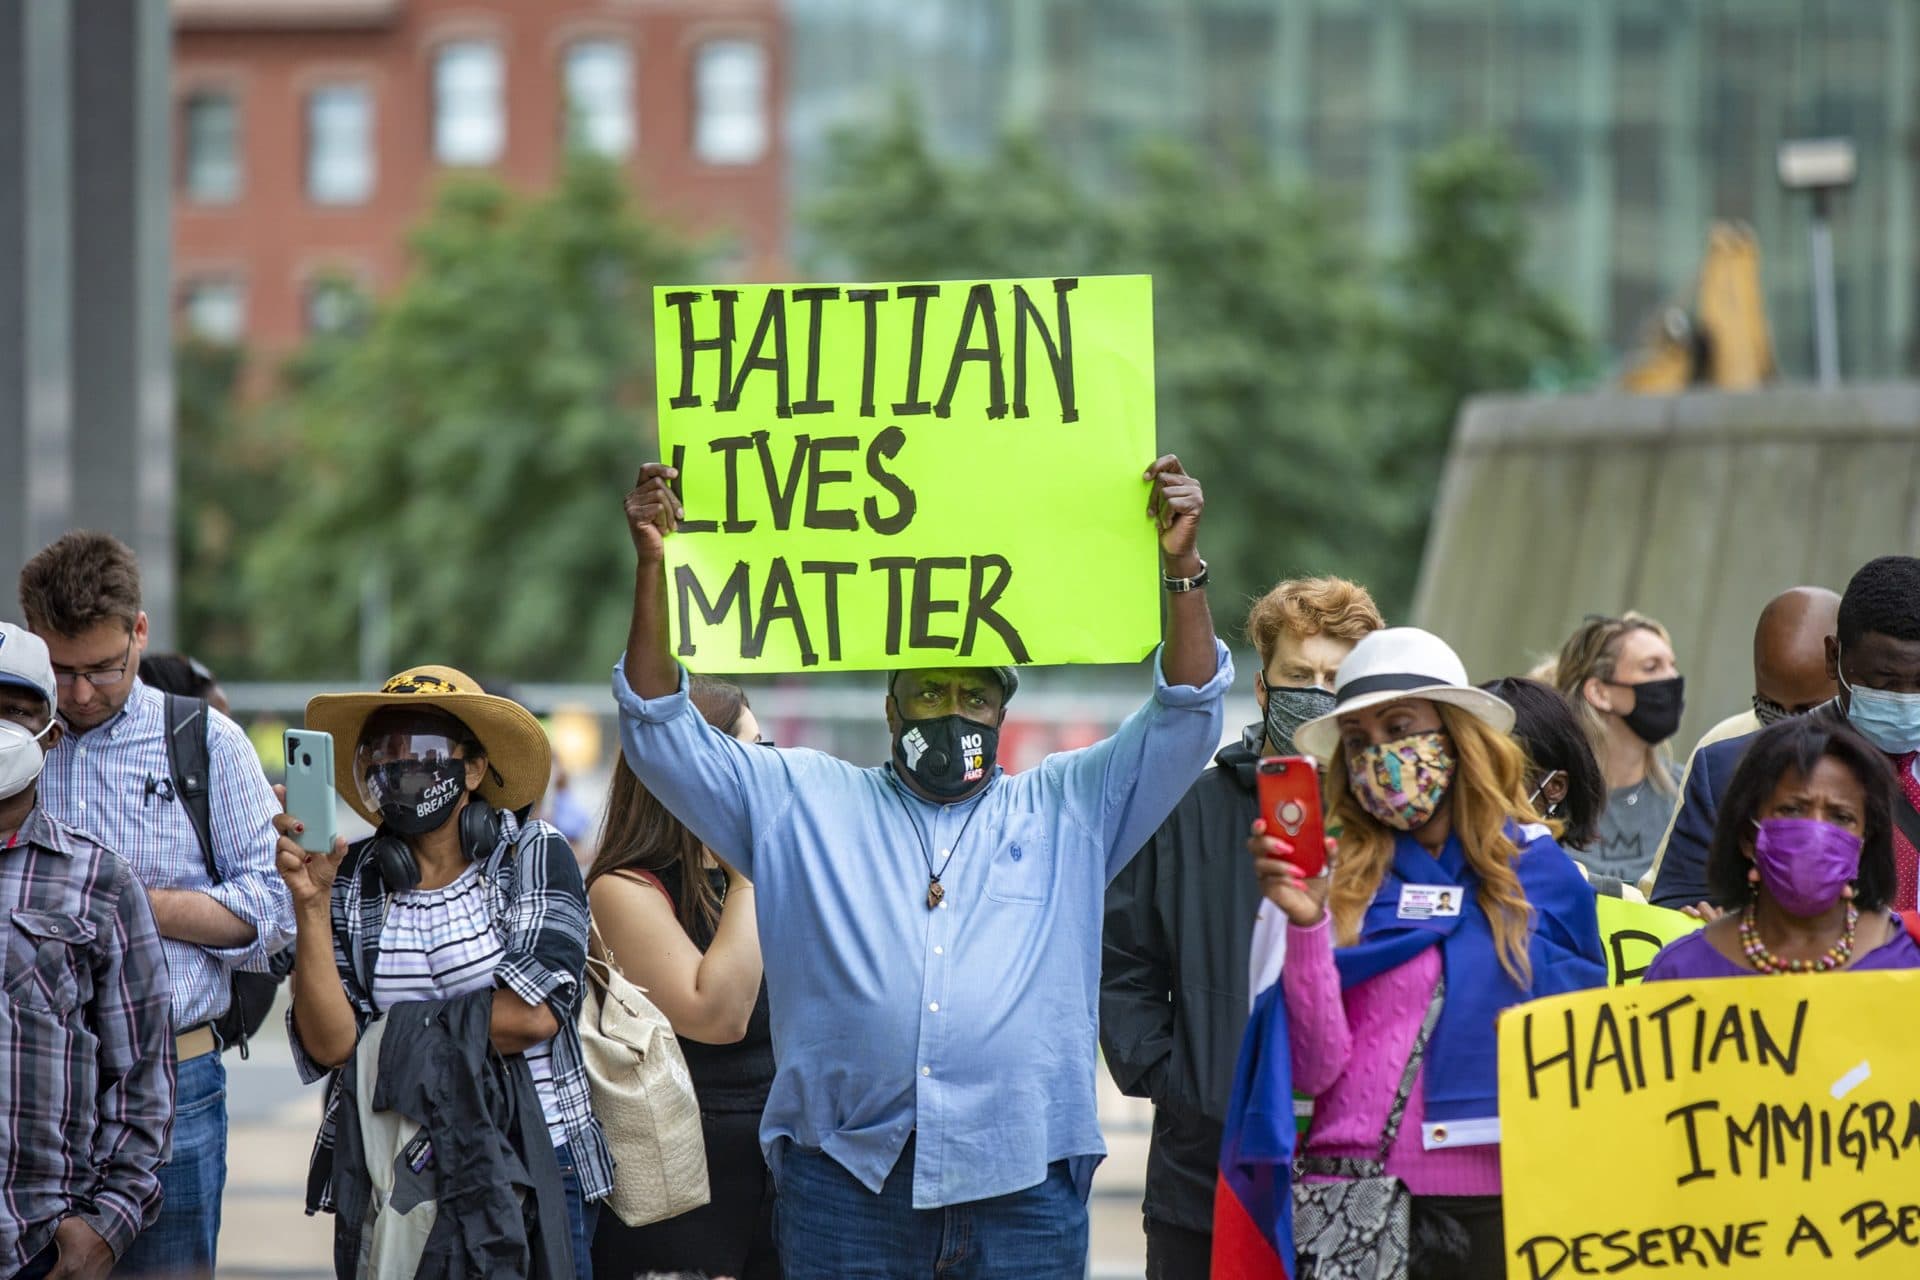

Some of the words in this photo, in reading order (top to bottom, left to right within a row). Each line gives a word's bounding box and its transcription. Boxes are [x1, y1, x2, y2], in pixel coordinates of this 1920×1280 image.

[665, 278, 1079, 423] HAITIAN
[671, 426, 917, 536] LIVES
[674, 554, 1033, 666] MATTER
[433, 770, 441, 782] I
[961, 733, 982, 749] NO
[964, 755, 983, 770] NO
[424, 778, 455, 798] CAN'T
[1523, 994, 1809, 1109] HAÏTIAN
[1516, 1221, 1768, 1280] DESERVE
[1786, 1215, 1833, 1259] A
[1839, 1200, 1920, 1260] BE
